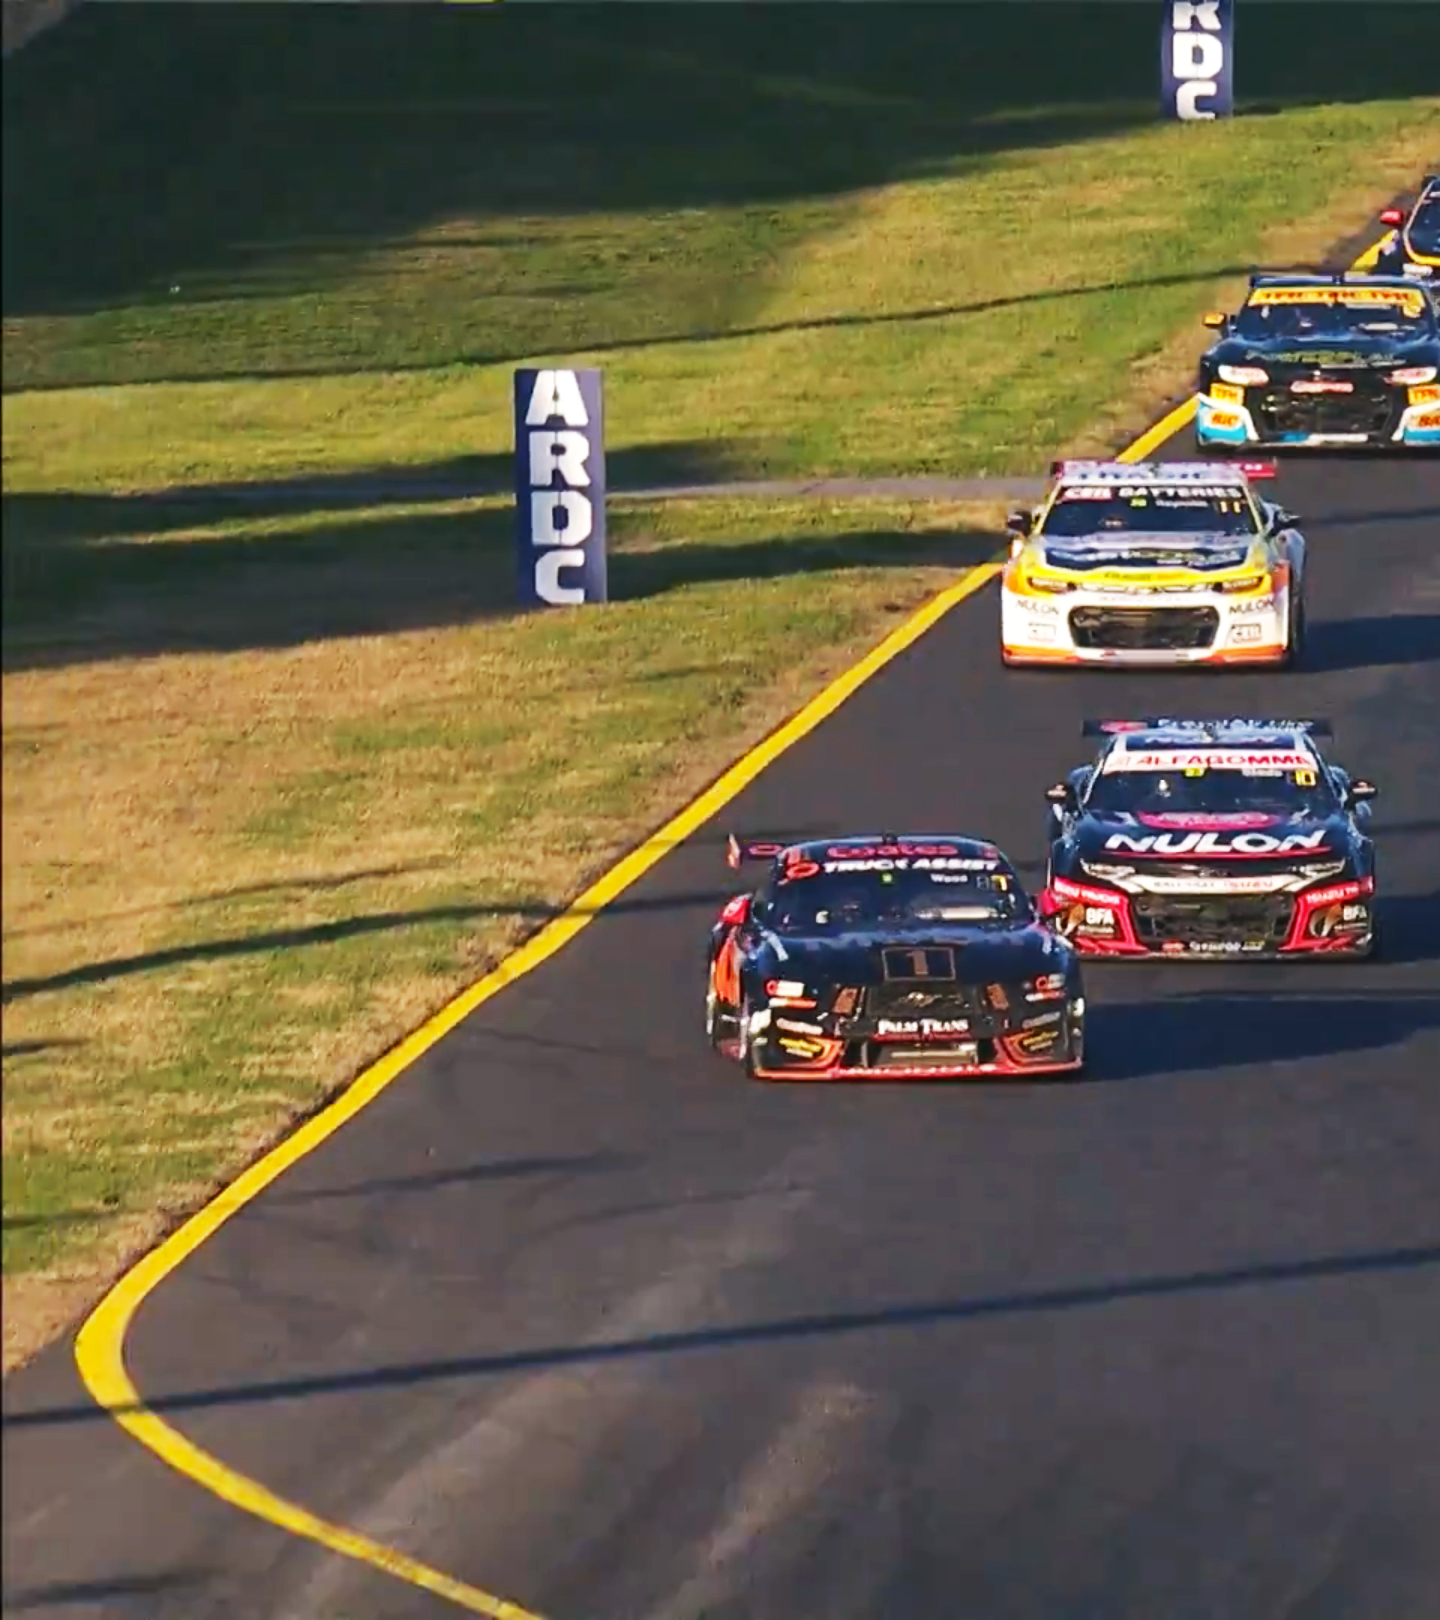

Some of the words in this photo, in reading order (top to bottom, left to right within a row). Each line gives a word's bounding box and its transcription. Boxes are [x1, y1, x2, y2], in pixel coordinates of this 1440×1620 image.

[525, 369, 592, 604] ARDC
[1118, 486, 1242, 498] BATTERIES
[1105, 830, 1327, 853] NULON
[828, 845, 958, 858] Coates
[823, 858, 910, 873] TRUCK
[912, 858, 1000, 871] ASSIST
[906, 950, 929, 975] 1
[921, 1018, 969, 1033] TRANS
